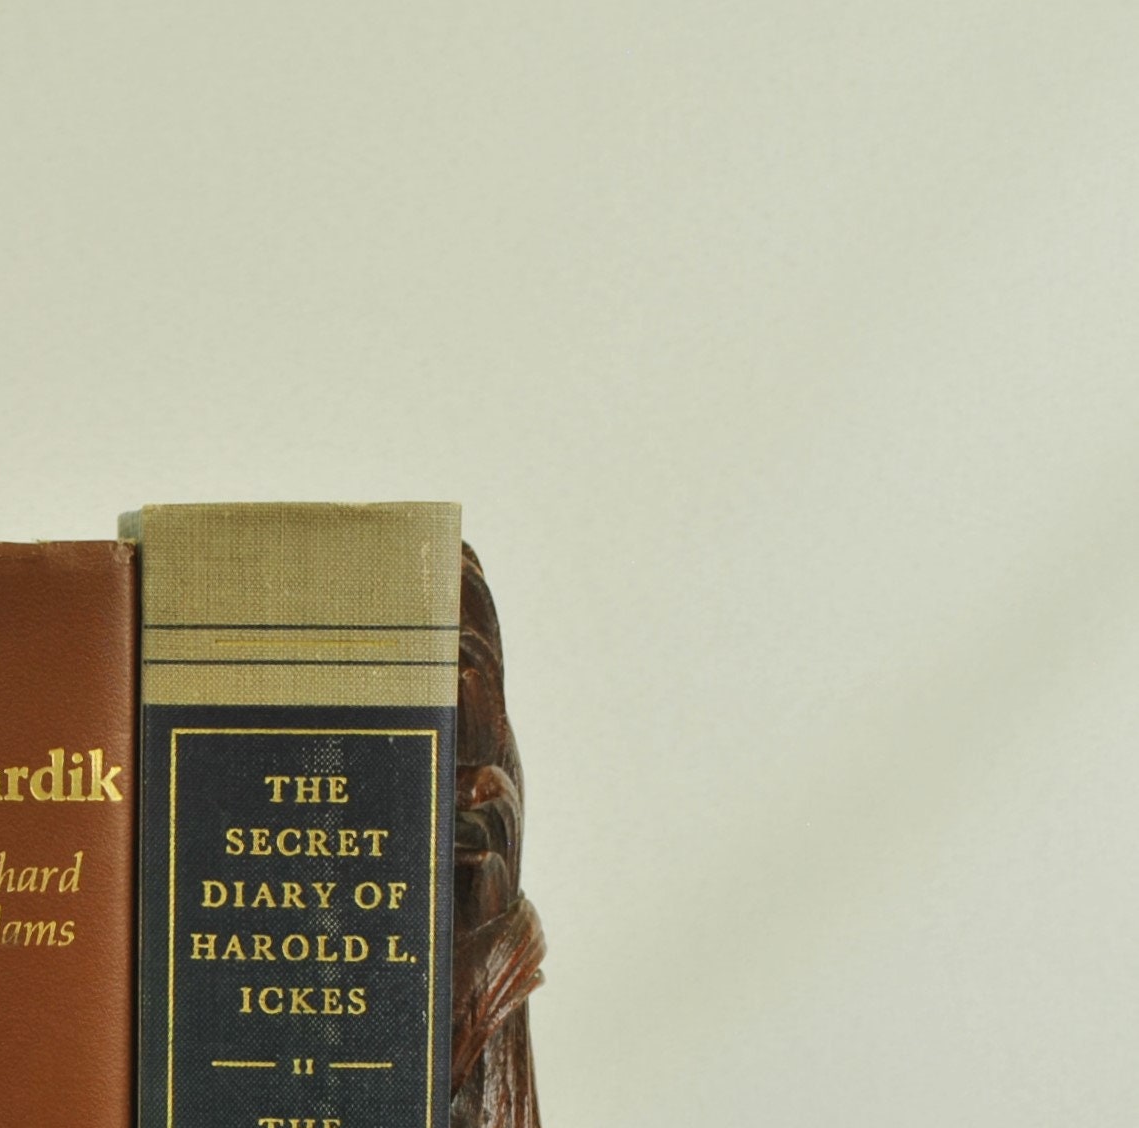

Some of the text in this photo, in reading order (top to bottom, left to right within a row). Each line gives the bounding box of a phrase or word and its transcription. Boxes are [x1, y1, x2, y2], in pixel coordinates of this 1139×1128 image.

[264, 776, 350, 803] THE
[225, 827, 389, 857] SECRET
[201, 880, 408, 909] DIARY OF
[190, 933, 418, 964] HAROLD L.
[239, 987, 368, 1015] ICKES
